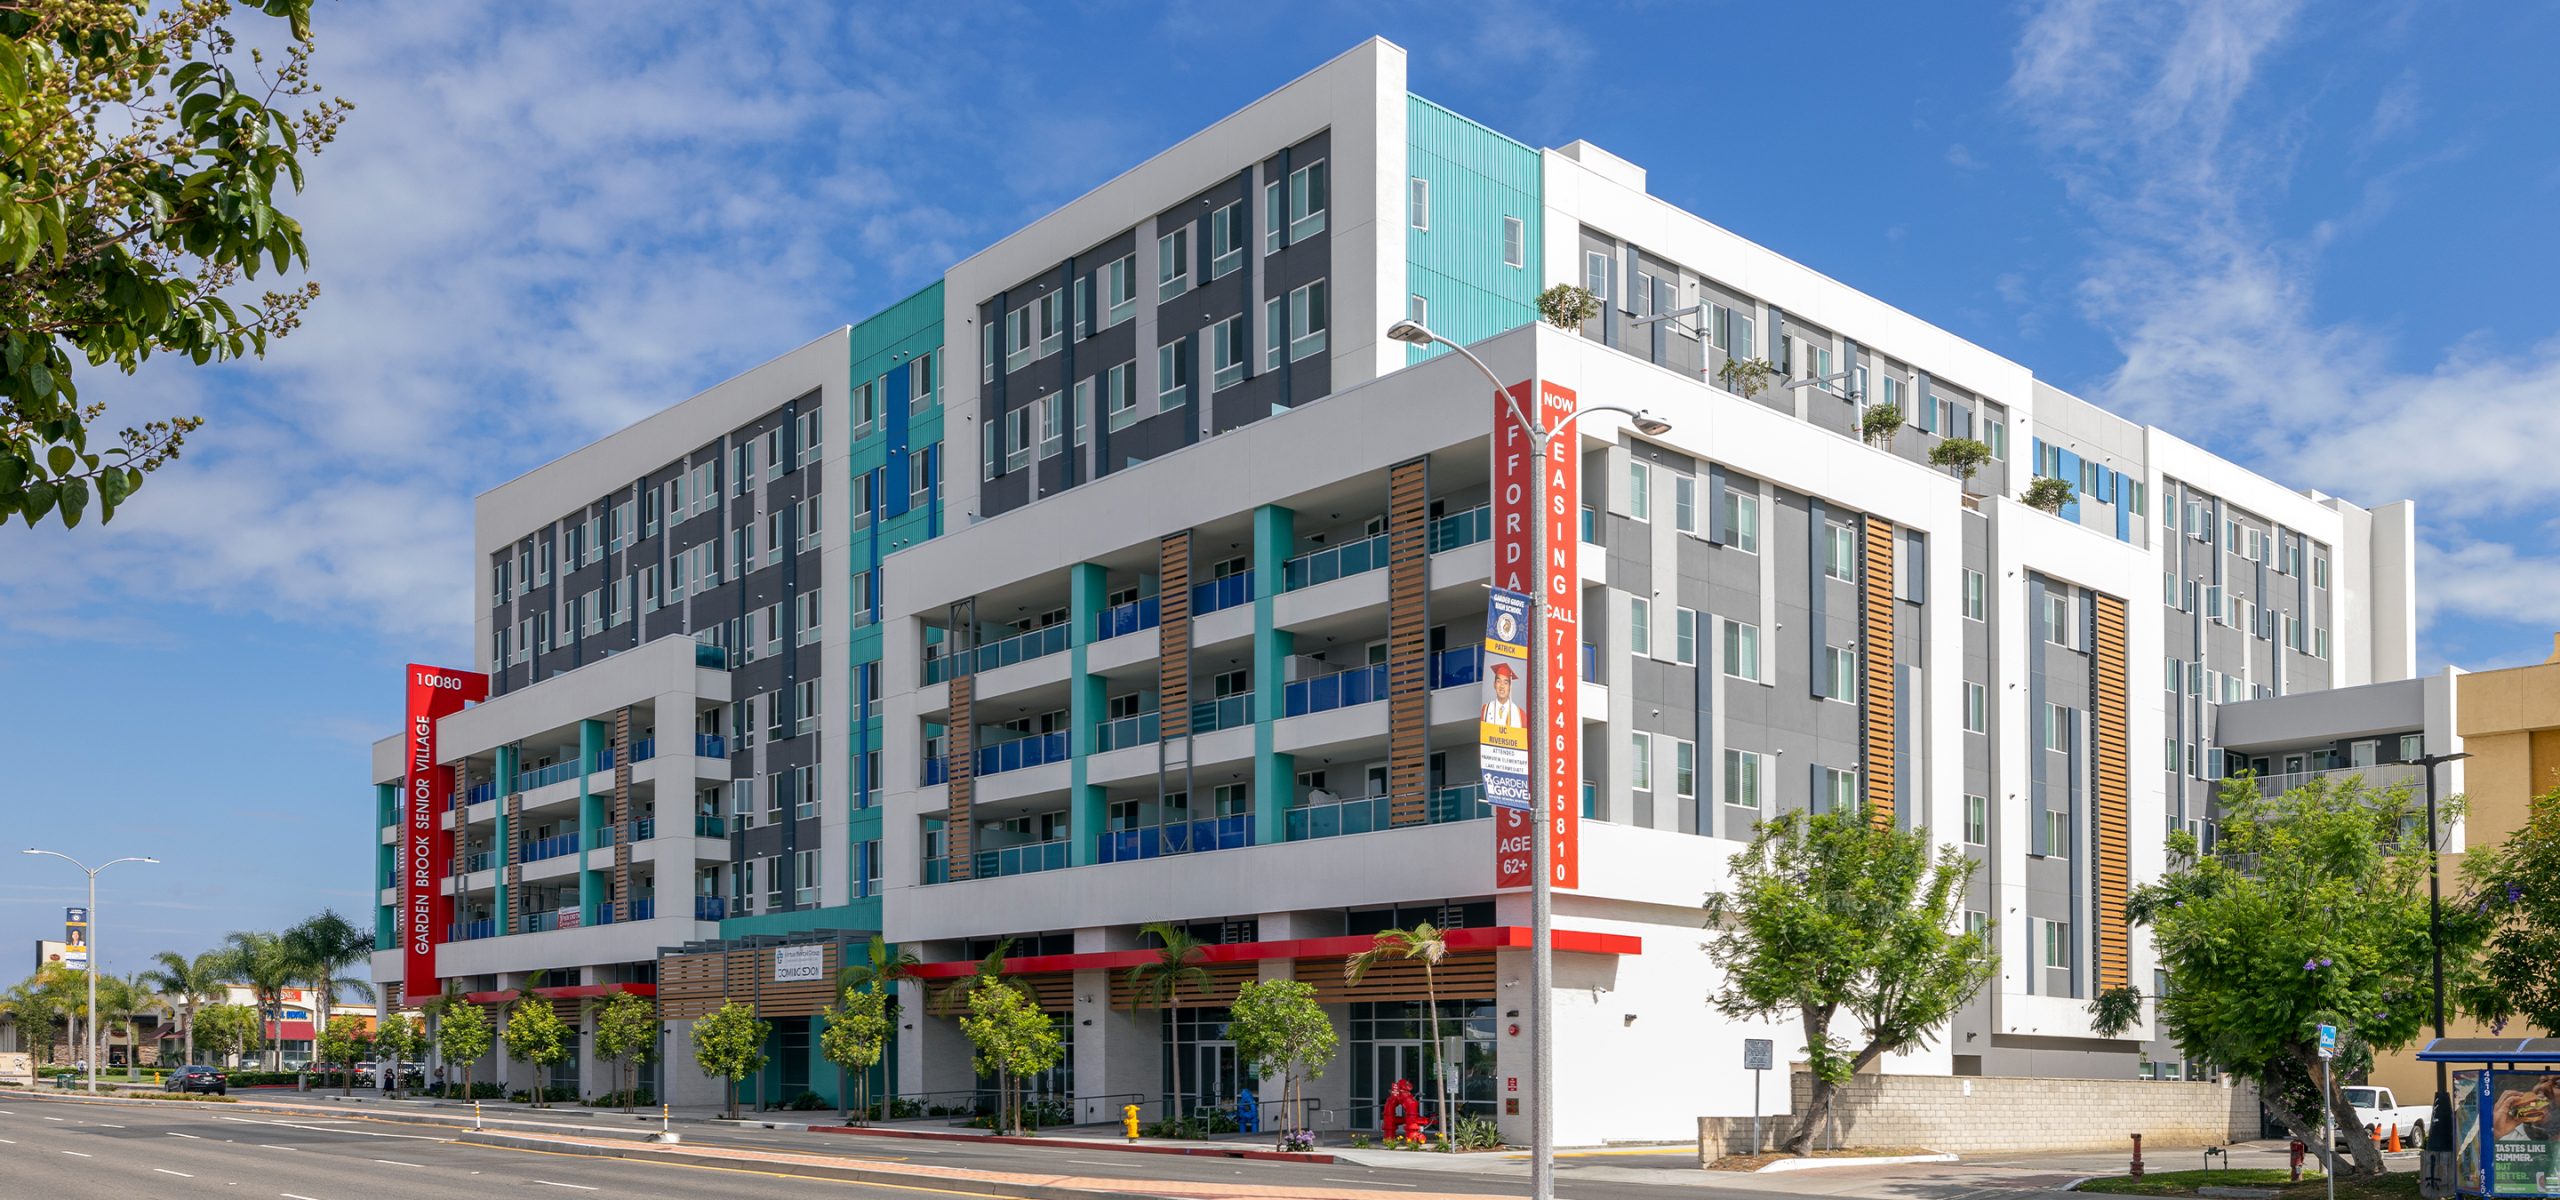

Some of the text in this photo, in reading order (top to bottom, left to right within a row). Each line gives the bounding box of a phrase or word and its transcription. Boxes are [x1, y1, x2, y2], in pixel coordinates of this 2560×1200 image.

[1544, 391, 1574, 414] NOW
[1552, 415, 1567, 595] LEASING
[1494, 593, 1525, 609] GARDEN GROVE
[1495, 602, 1522, 615] HIGH SCHOOL
[1547, 604, 1576, 623] CALL
[1495, 643, 1516, 655] PATRICK
[416, 673, 462, 691] 10080
[1499, 726, 1507, 735] UC
[1489, 735, 1518, 748] RIVERSIDE
[1492, 775, 1528, 789] GARDEN
[1494, 785, 1529, 800] GROVE
[415, 715, 430, 955] GARDEN BROOK SENIOR VILLAGE
[1500, 836, 1531, 853] AGE
[1503, 858, 1528, 874] 62+
[778, 966, 820, 978] COMING SOON
[2495, 1143, 2546, 1153] TASTES LIKE
[2495, 1153, 2534, 1162] SUMMER.
[2495, 1162, 2512, 1170] BUT
[2495, 1171, 2530, 1180] BETTER.
